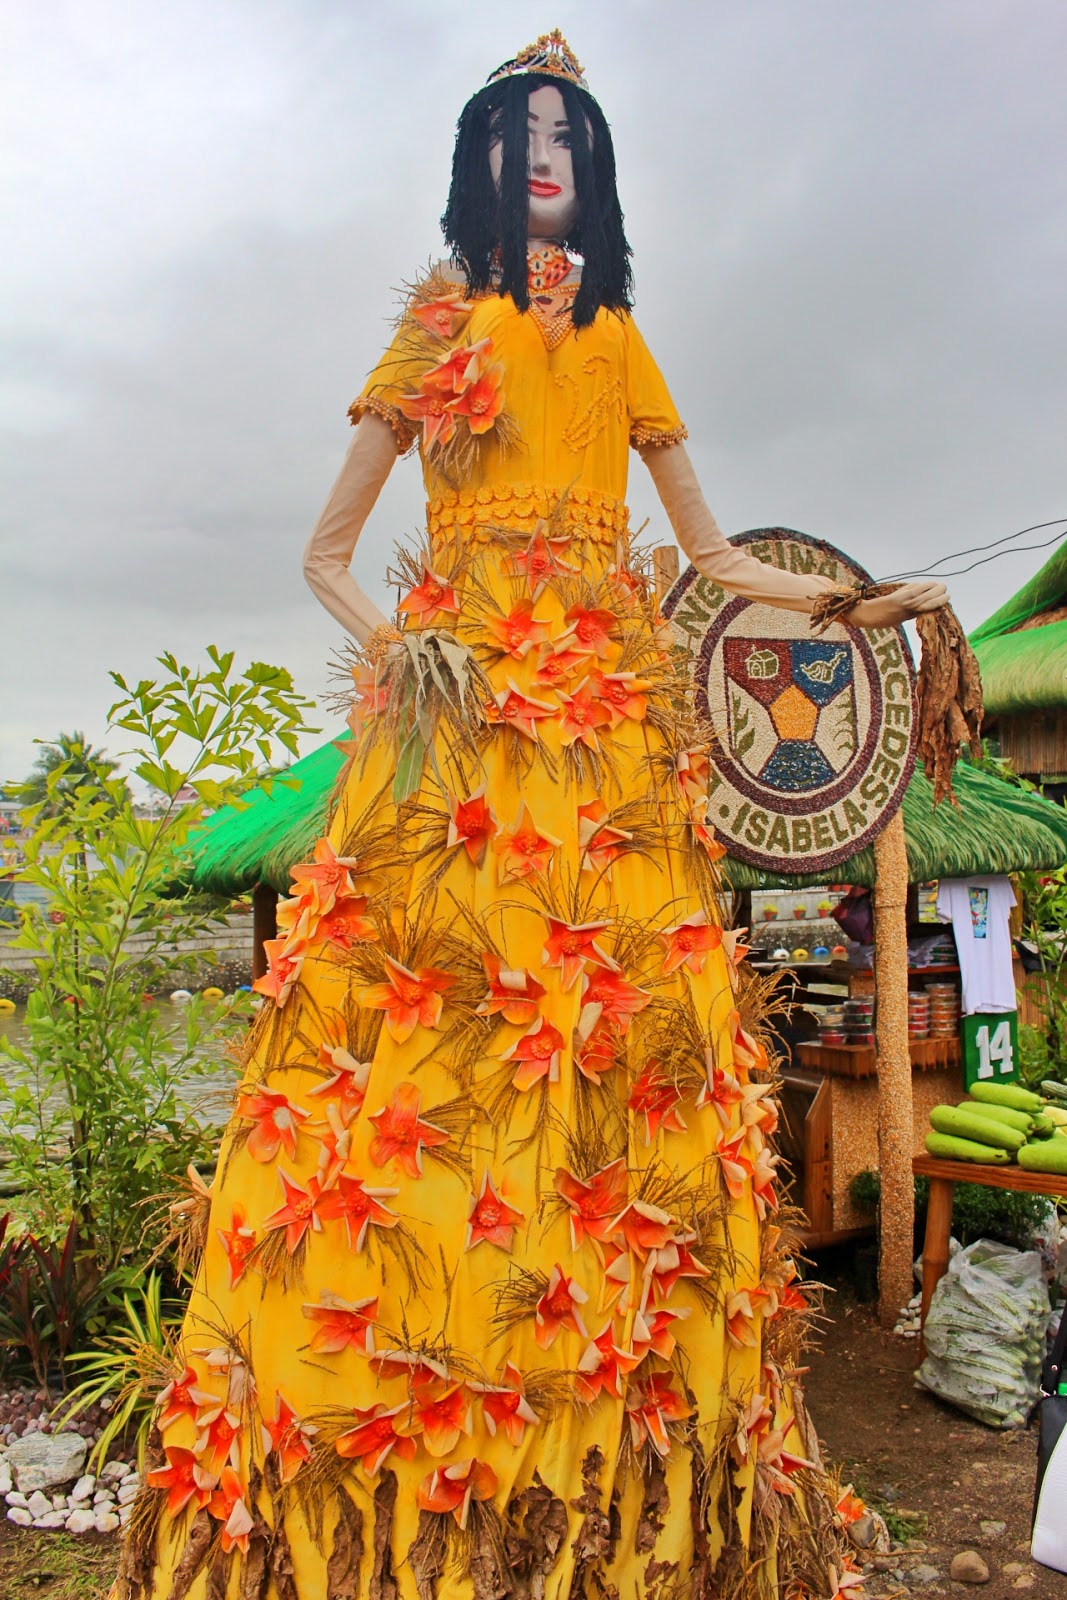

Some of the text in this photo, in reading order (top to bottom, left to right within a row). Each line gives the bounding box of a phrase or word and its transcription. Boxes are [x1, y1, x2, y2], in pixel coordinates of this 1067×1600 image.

[750, 540, 838, 582] EINA
[857, 626, 910, 808] ERCEDES
[731, 798, 868, 854] ISABELA
[975, 1021, 1014, 1080] 14
